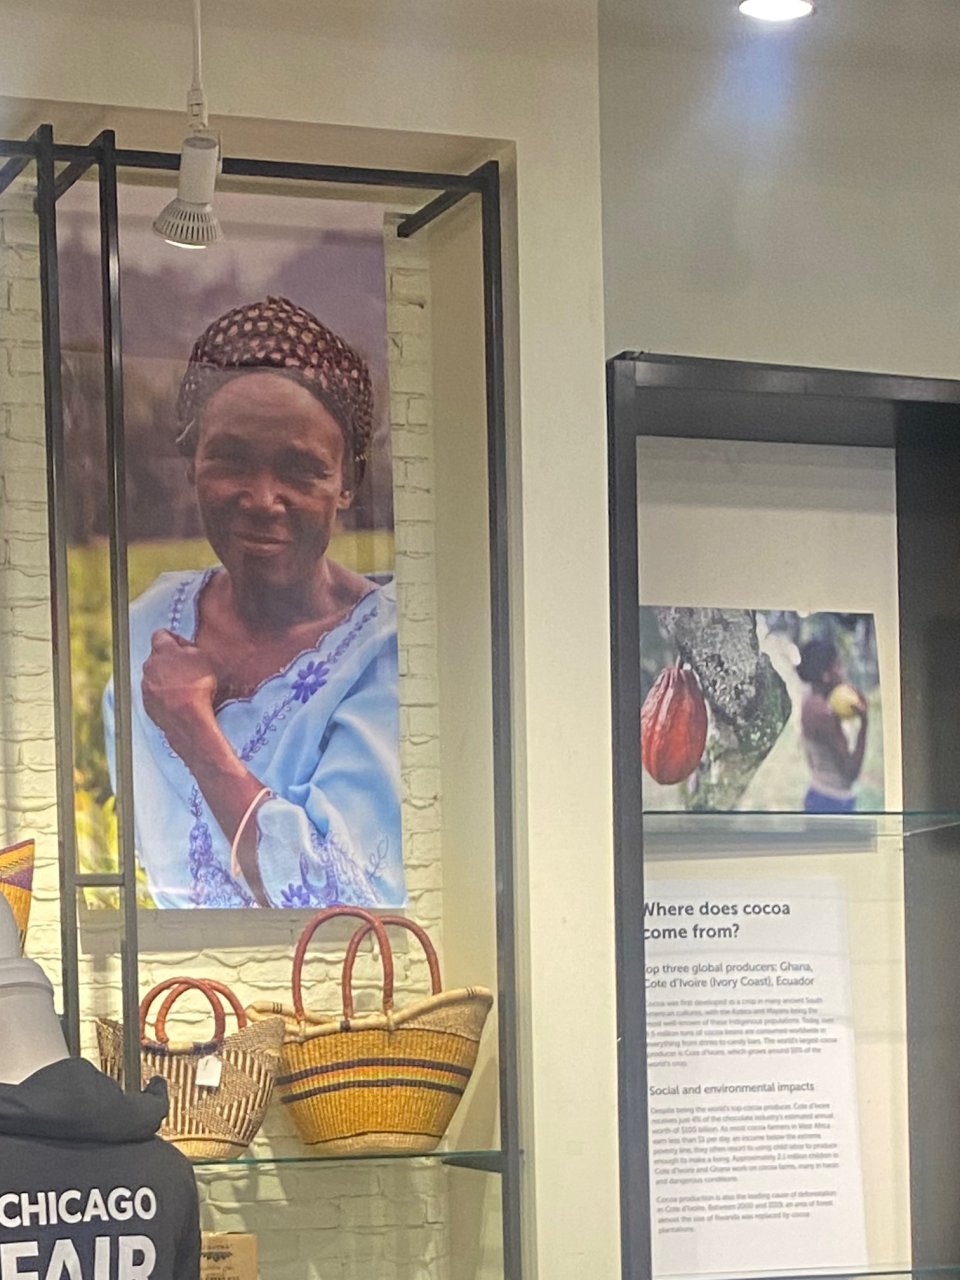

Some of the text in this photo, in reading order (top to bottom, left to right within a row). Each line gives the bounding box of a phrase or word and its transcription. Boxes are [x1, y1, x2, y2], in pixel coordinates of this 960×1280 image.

[643, 901, 791, 917] Where does cocoa
[643, 923, 740, 940] come from?
[645, 964, 660, 976] op
[663, 963, 689, 974] three
[692, 962, 723, 975] global
[710, 976, 738, 989] (Ivory
[776, 975, 815, 986] Ecuador
[649, 1081, 815, 1096] Social and environmental impacts
